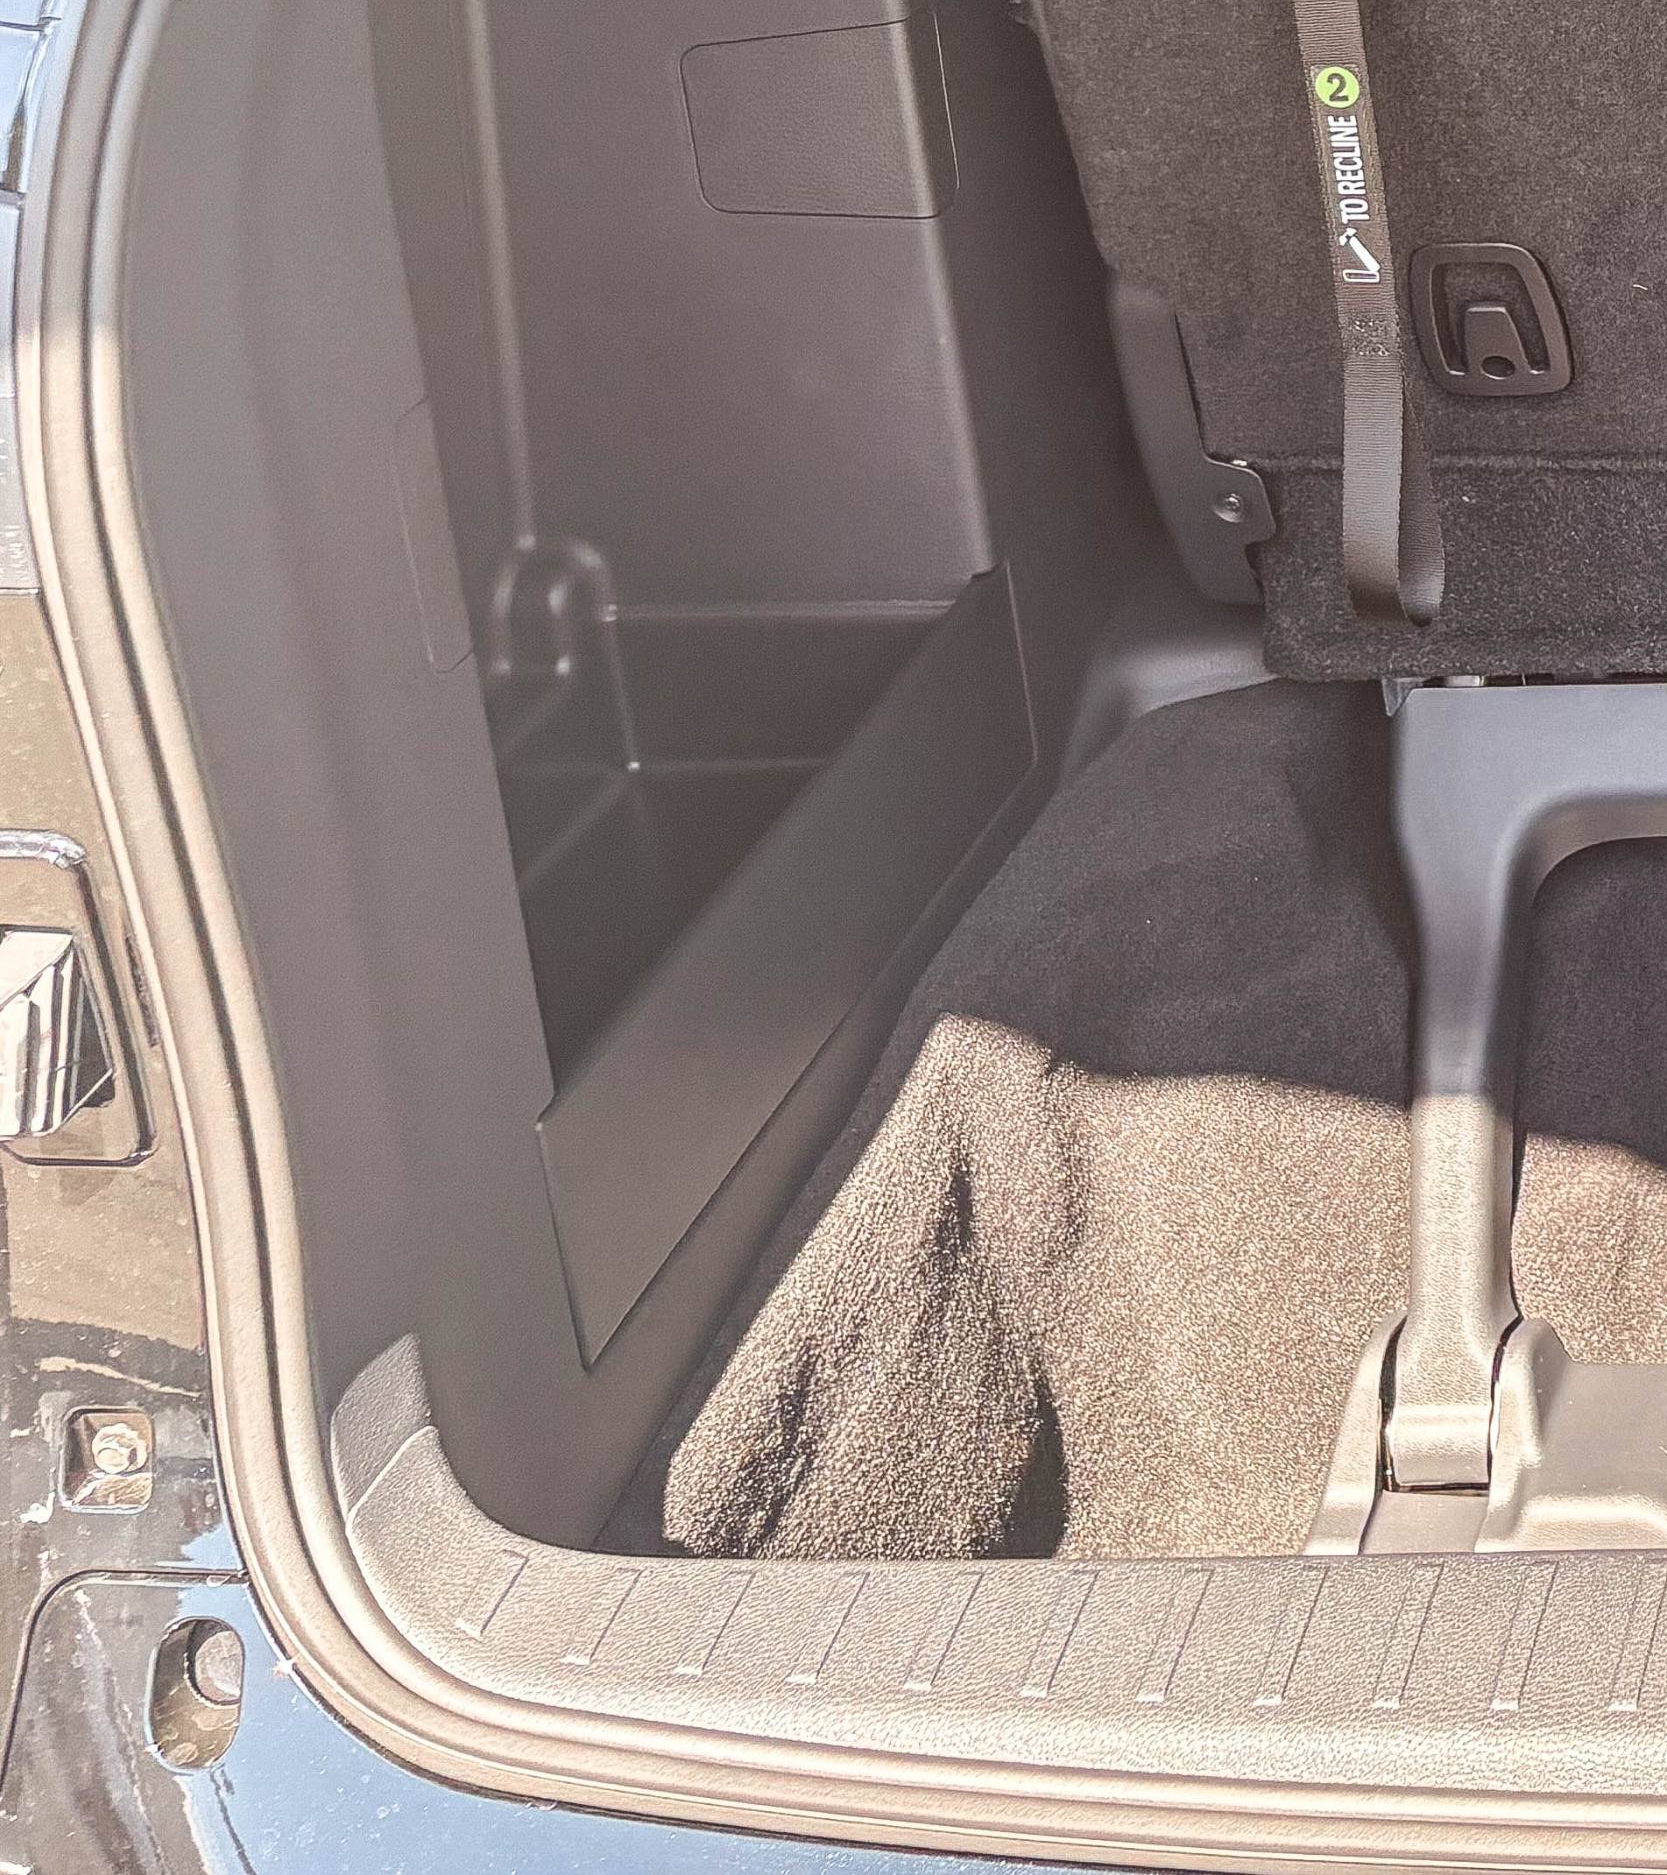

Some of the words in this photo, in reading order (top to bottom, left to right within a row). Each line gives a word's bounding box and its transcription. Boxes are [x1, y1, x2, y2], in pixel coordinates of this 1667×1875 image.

[1326, 73, 1350, 103] 2
[1327, 115, 1367, 196] RECLINE
[1339, 198, 1370, 224] TO
